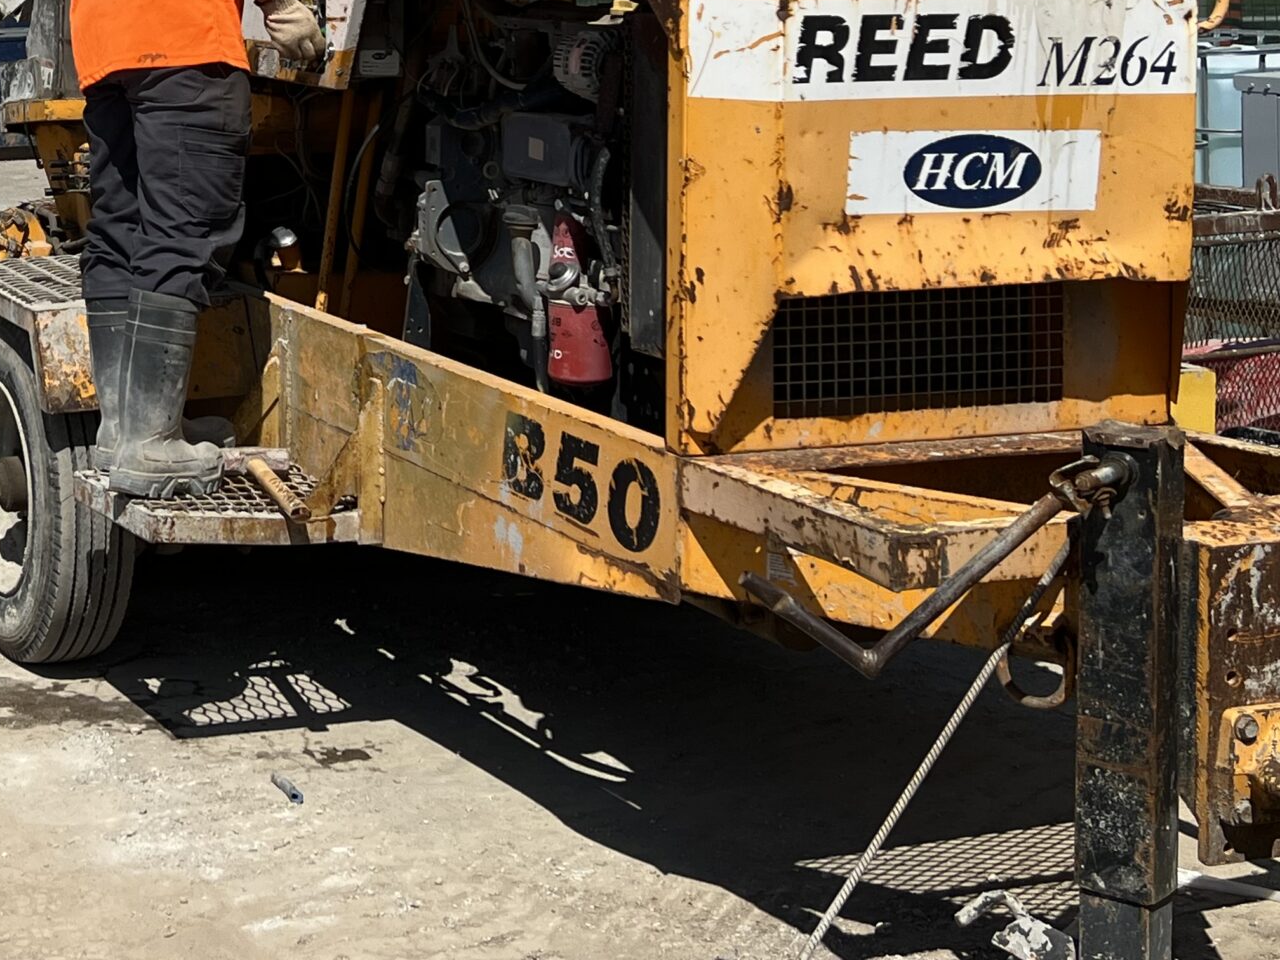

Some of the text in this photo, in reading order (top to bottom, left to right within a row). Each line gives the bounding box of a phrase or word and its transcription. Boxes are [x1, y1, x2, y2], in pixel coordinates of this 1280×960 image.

[792, 13, 1177, 87] REED M264
[910, 152, 1033, 191] HCM
[502, 411, 660, 553] B50
